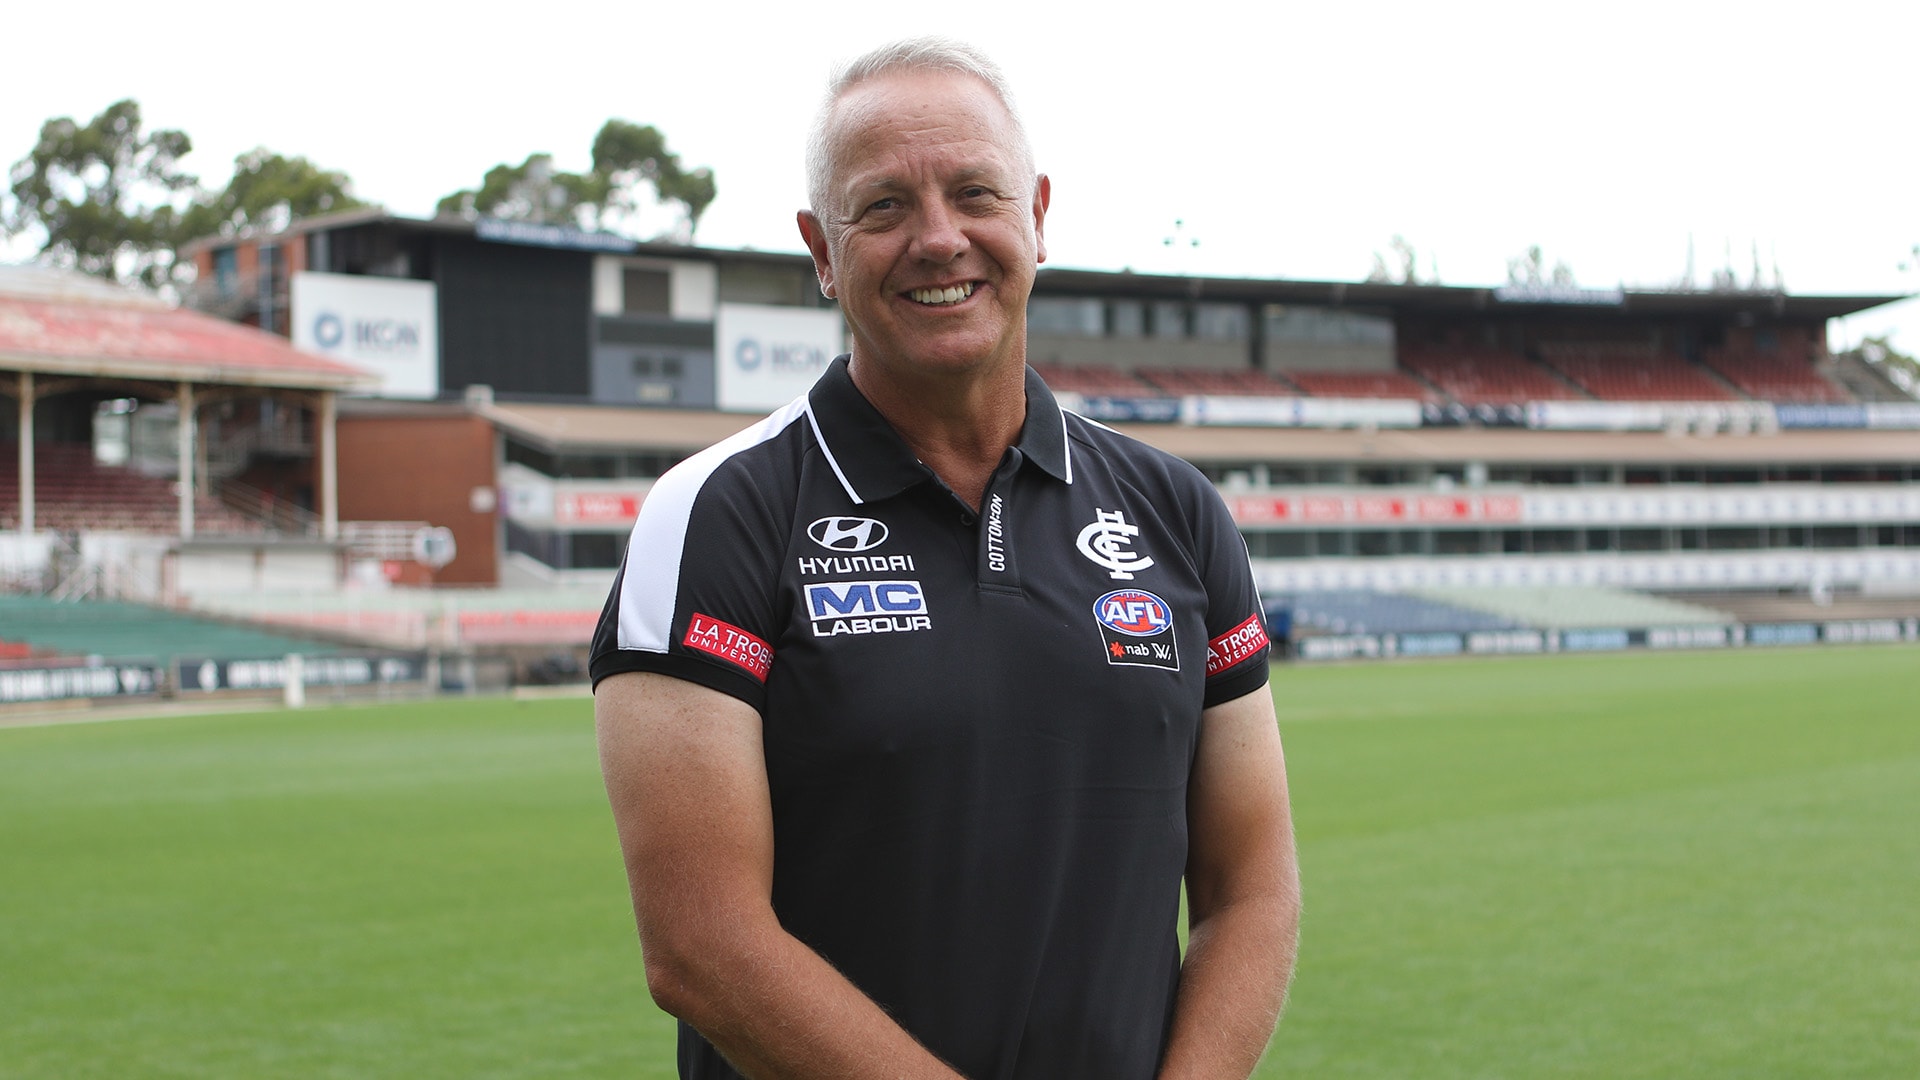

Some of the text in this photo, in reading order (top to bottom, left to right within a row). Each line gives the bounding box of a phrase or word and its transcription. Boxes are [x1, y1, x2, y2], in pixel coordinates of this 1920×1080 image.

[988, 493, 1006, 572] COTTON:ON
[799, 555, 915, 575] HYUNDAI
[810, 584, 921, 617] MC
[1104, 600, 1167, 625] AFL
[694, 619, 719, 640] LA
[812, 616, 932, 637] LABOUR
[1218, 619, 1260, 653] TROBE
[1125, 643, 1150, 656] nab
